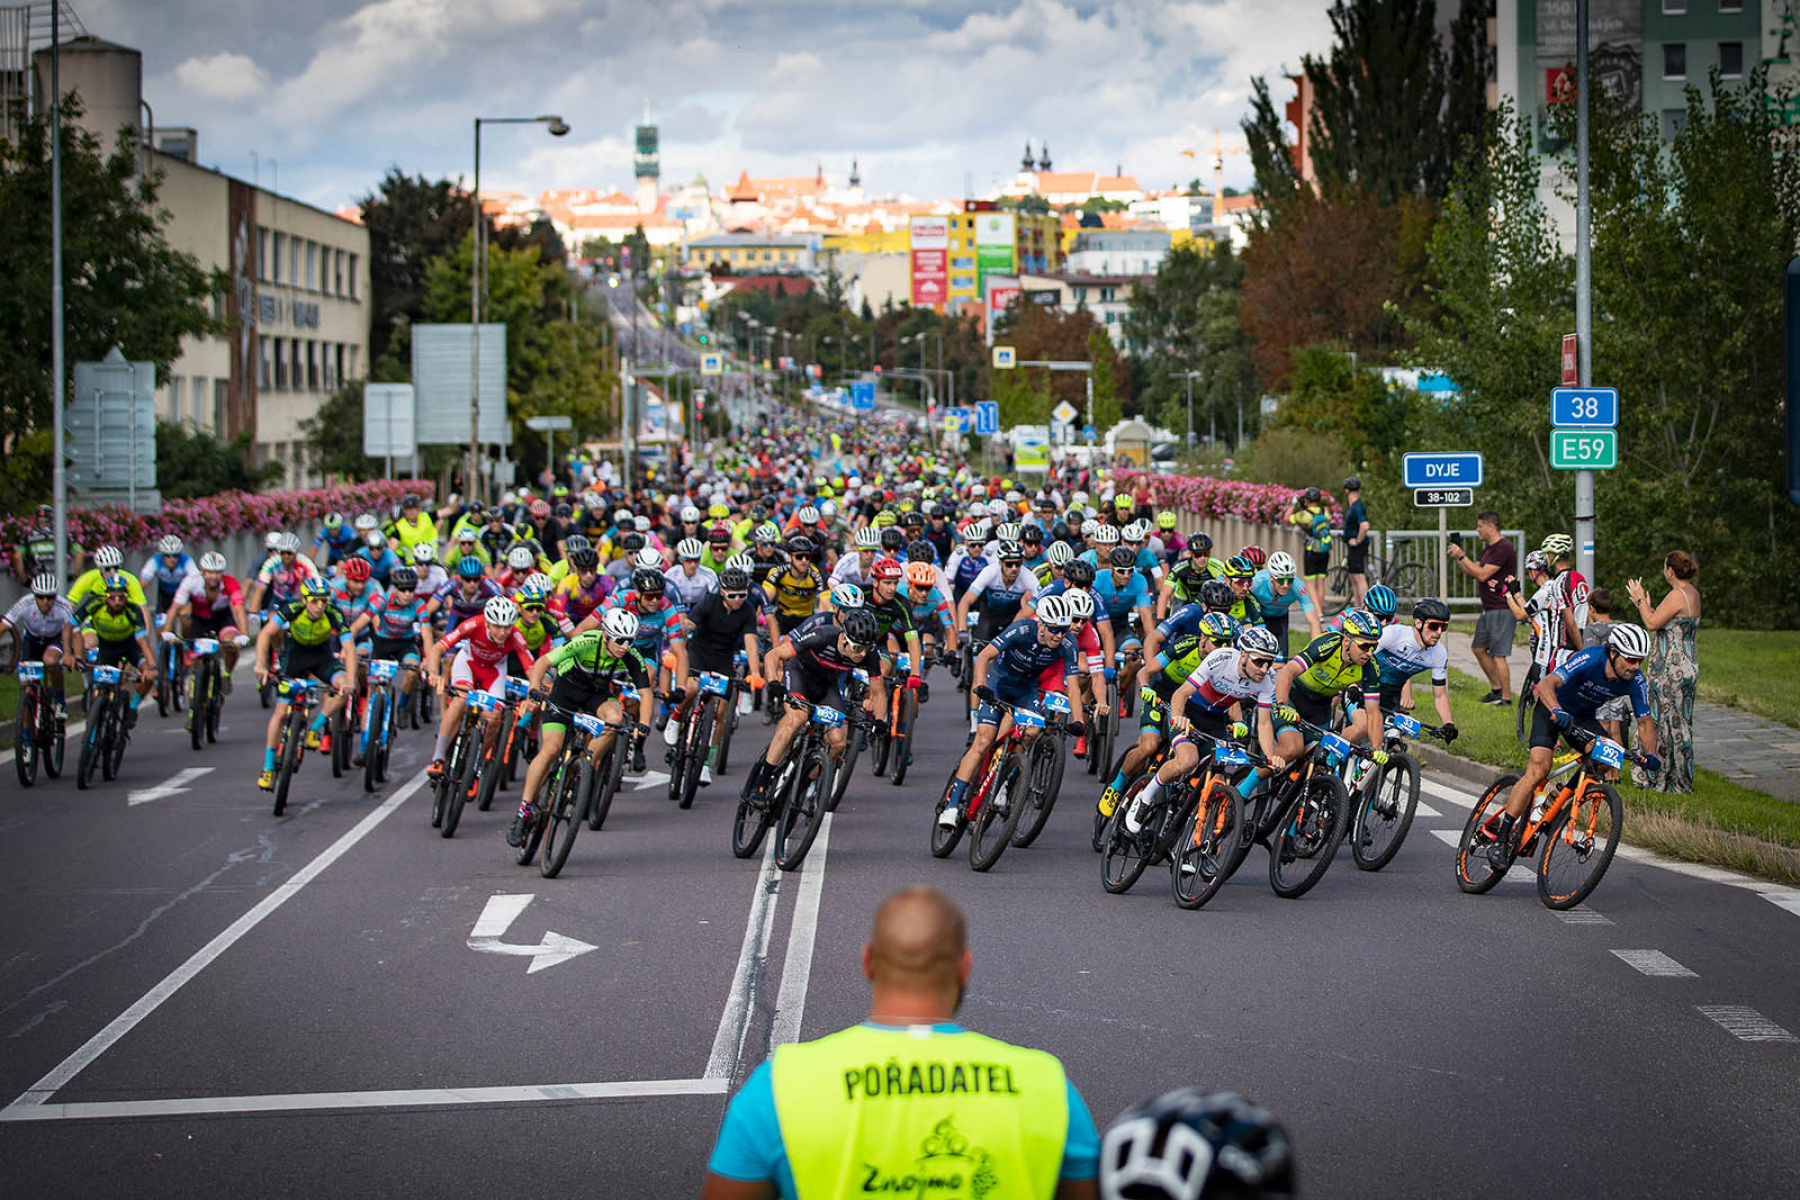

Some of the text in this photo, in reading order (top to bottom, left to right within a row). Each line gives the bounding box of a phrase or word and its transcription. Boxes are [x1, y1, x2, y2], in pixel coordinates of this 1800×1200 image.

[1571, 397, 1599, 418] 38
[1563, 438, 1605, 460] E59
[1425, 463, 1461, 478] DYJE
[1427, 492, 1460, 503] 38-102
[1602, 745, 1619, 760] 992
[845, 1056, 1019, 1100] POŘADATEL
